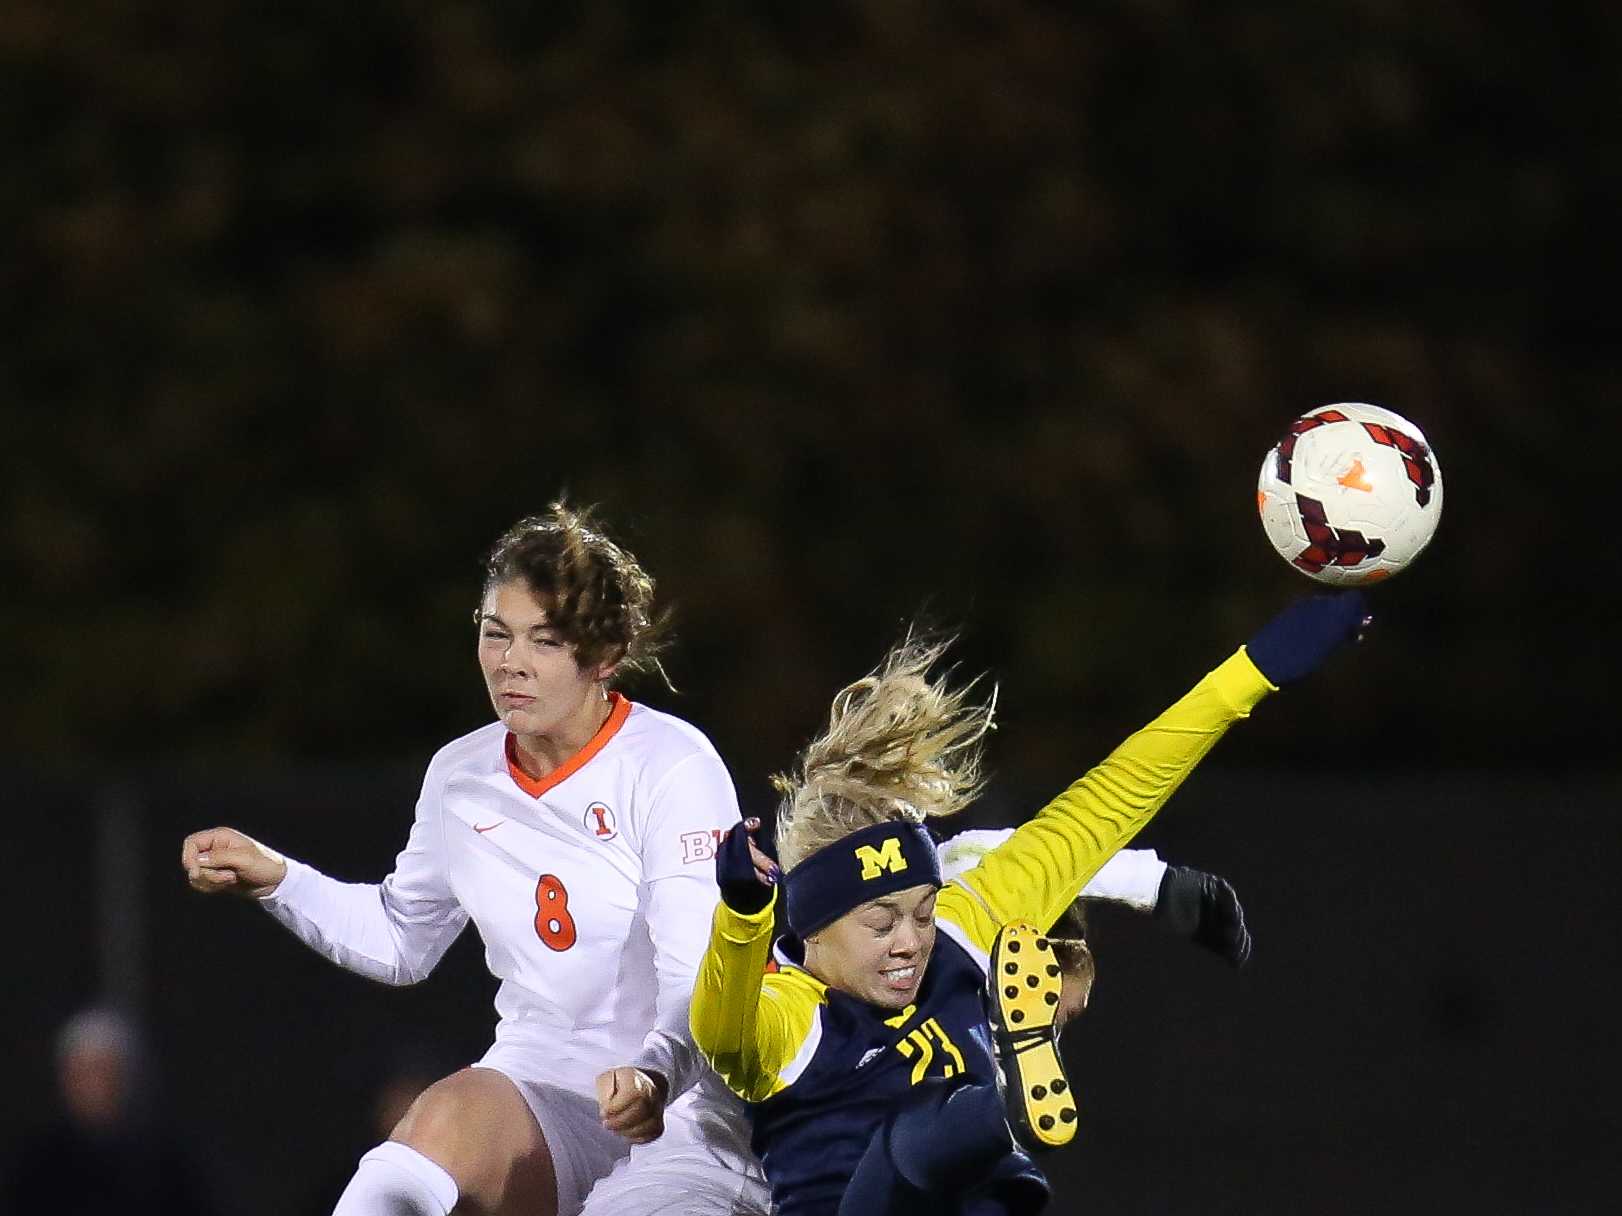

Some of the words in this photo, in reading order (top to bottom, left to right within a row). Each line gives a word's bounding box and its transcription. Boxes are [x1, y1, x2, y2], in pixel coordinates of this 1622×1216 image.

[592, 807, 612, 836] I
[855, 838, 907, 881] M
[534, 873, 577, 952] 8
